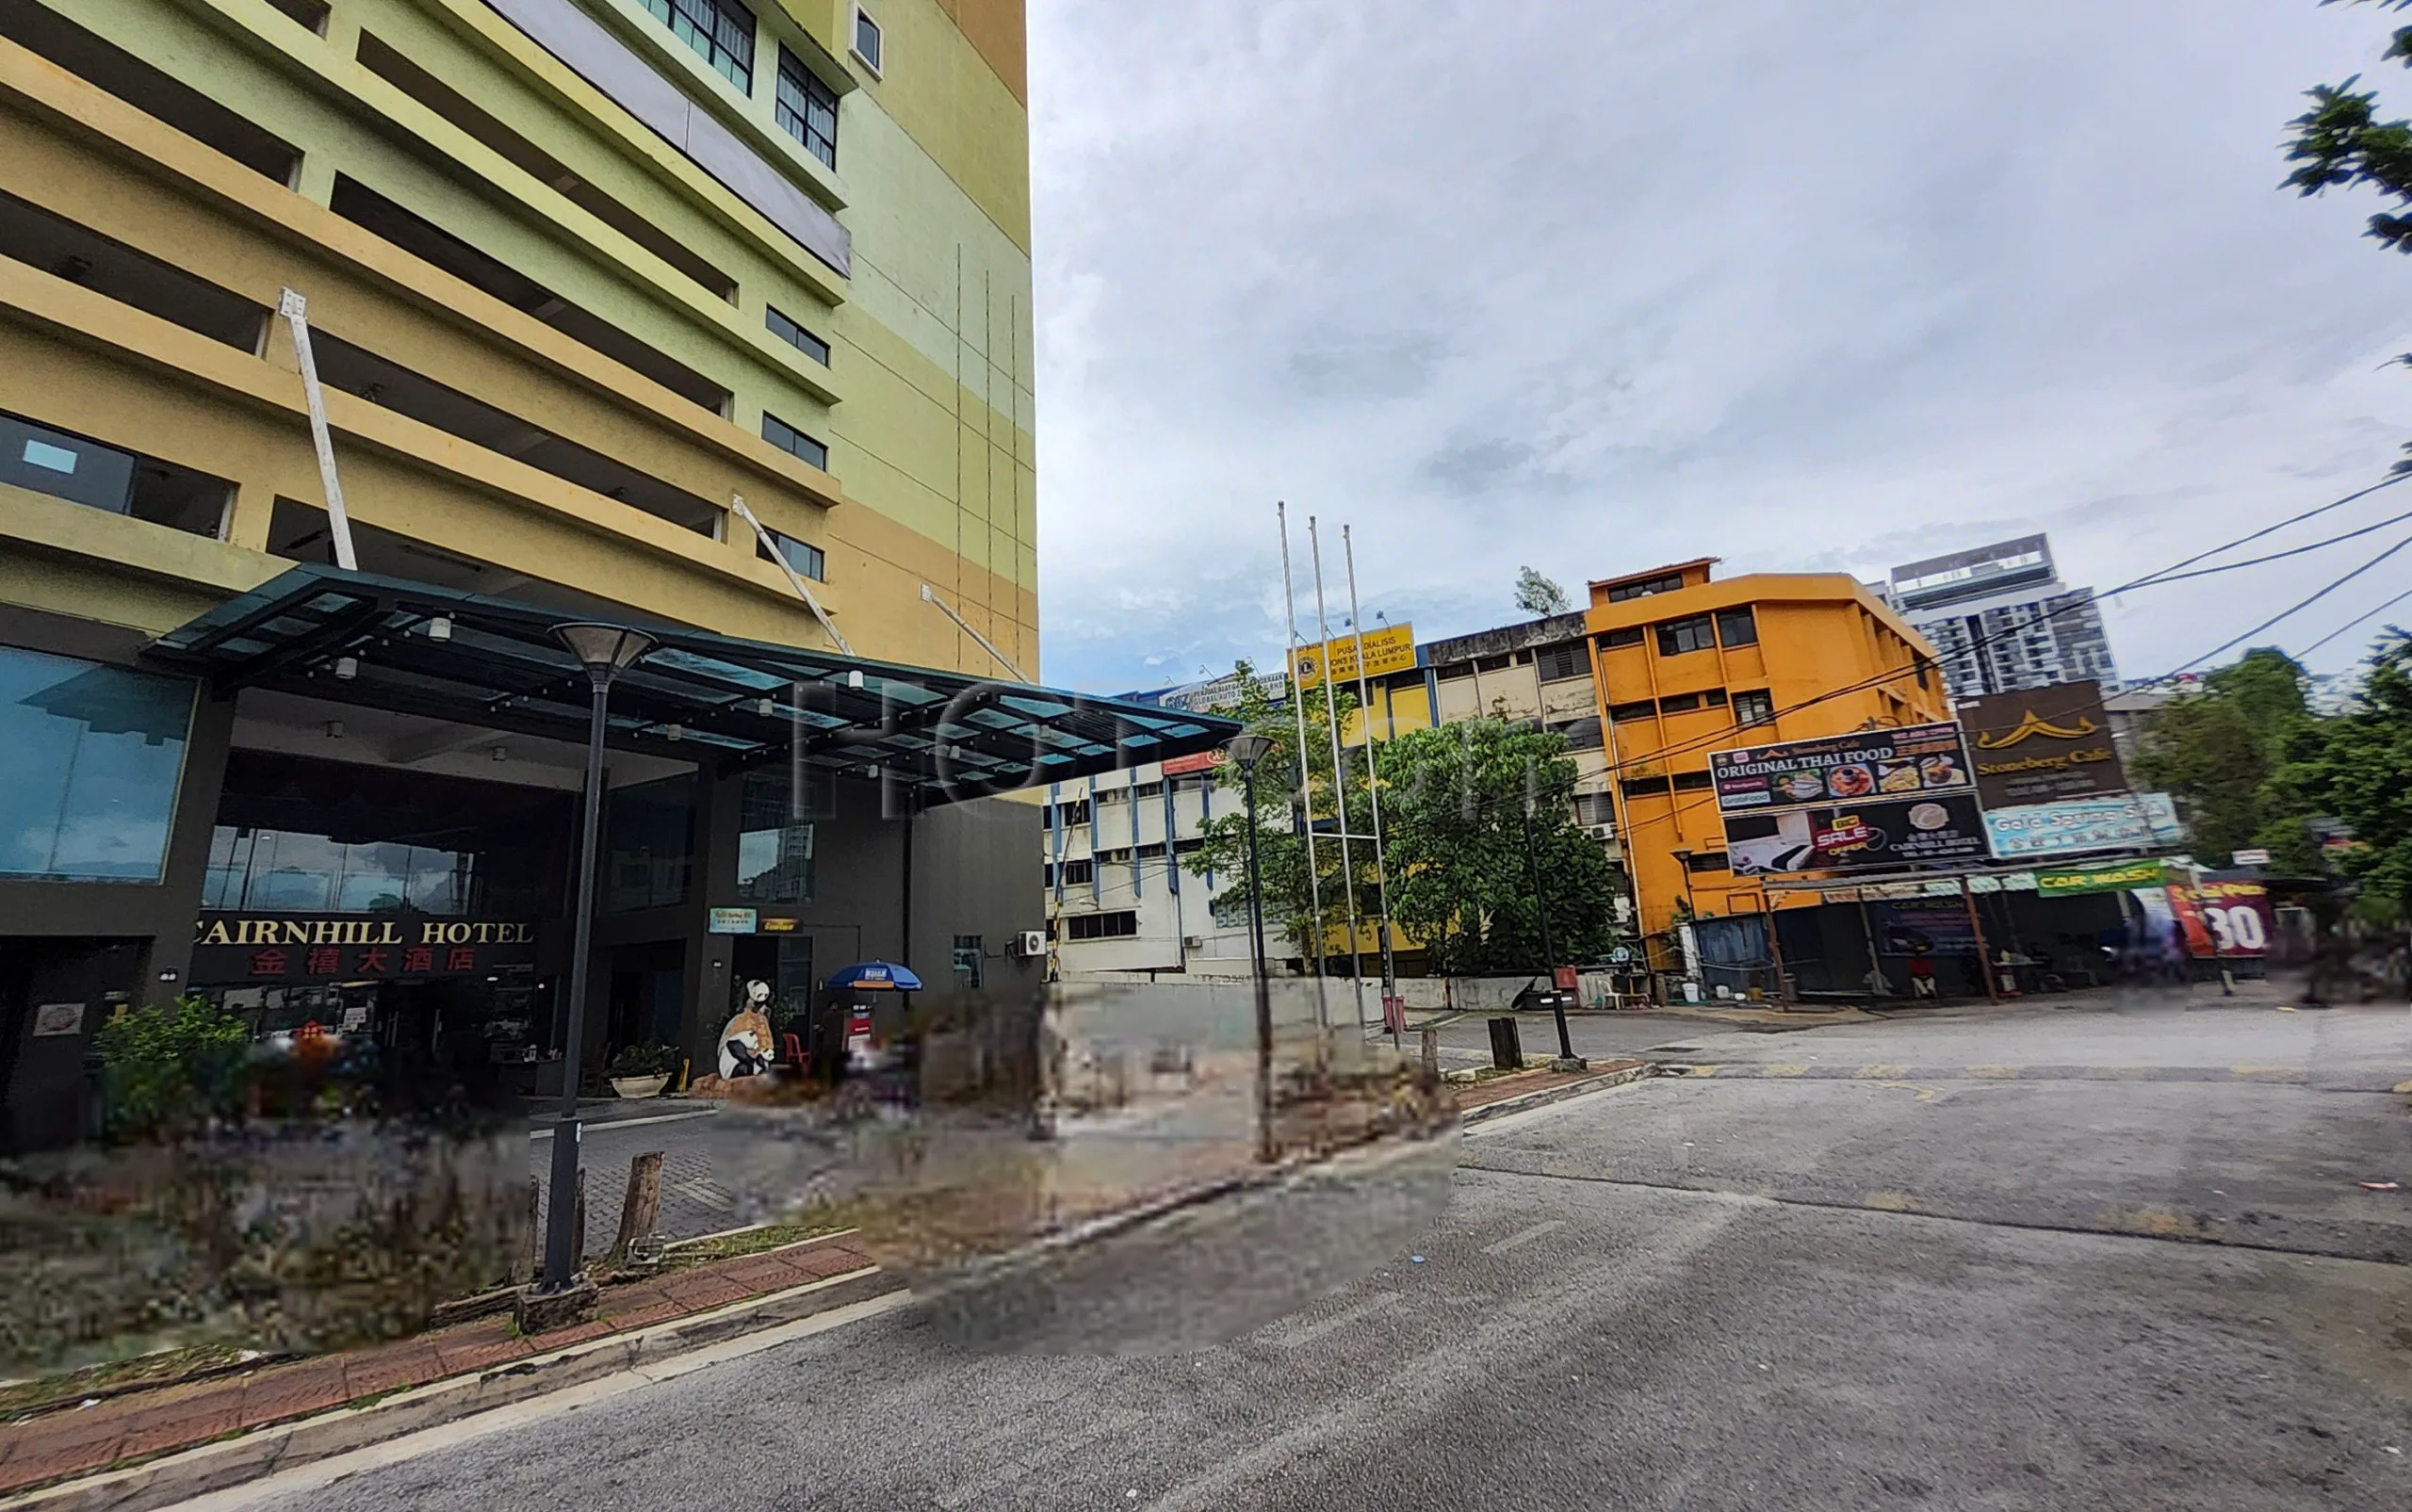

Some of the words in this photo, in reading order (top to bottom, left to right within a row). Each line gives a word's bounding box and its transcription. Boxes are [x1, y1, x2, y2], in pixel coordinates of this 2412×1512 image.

[1337, 644, 1361, 656] PUSA
[1363, 636, 1396, 650] DIALISIS
[1377, 643, 1411, 658] LUMPUR
[1193, 694, 1217, 706] GLOBAL
[1218, 691, 1235, 701] AUTO
[1717, 759, 1799, 779] ORIGINAL
[1799, 755, 1844, 770] THAI
[1844, 746, 1894, 764] FOOD
[1977, 756, 2070, 774] Stoneberg
[1993, 812, 2044, 832] Gold
[1817, 827, 1870, 847] SALE
[2038, 874, 2087, 888] CAR
[2092, 868, 2160, 885] WASH
[420, 921, 535, 945] HOTEL
[2204, 905, 2265, 950] 30
[250, 946, 477, 976] 金禧大酒店
